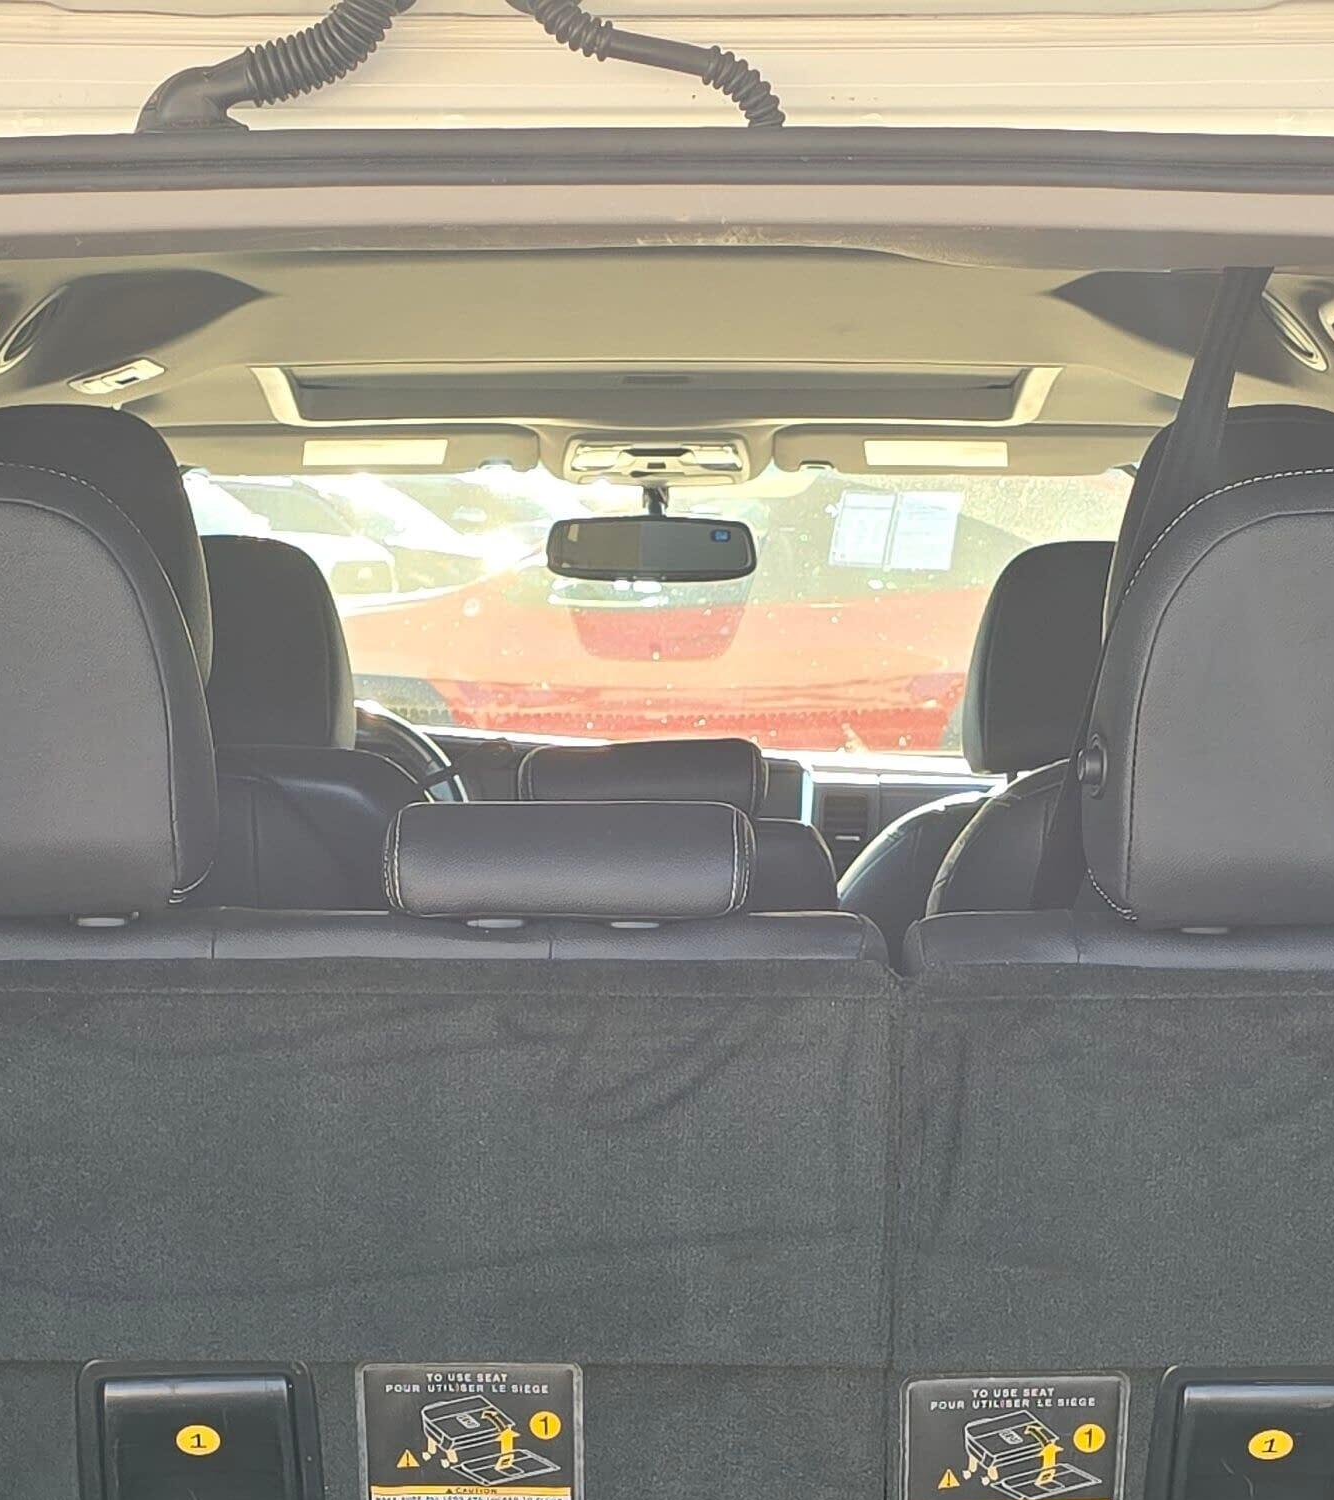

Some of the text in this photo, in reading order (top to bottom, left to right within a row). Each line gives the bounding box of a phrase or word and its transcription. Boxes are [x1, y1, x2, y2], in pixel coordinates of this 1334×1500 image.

[426, 1373, 508, 1383] TO USE SEAT
[385, 1384, 420, 1393] POUR
[427, 1384, 484, 1393] UTILISER
[492, 1384, 506, 1393] LE
[972, 1388, 1054, 1398] TO USE SEAT
[930, 1401, 965, 1410] POUR
[972, 1399, 1030, 1409] UTILISER
[1037, 1398, 1054, 1407] LE
